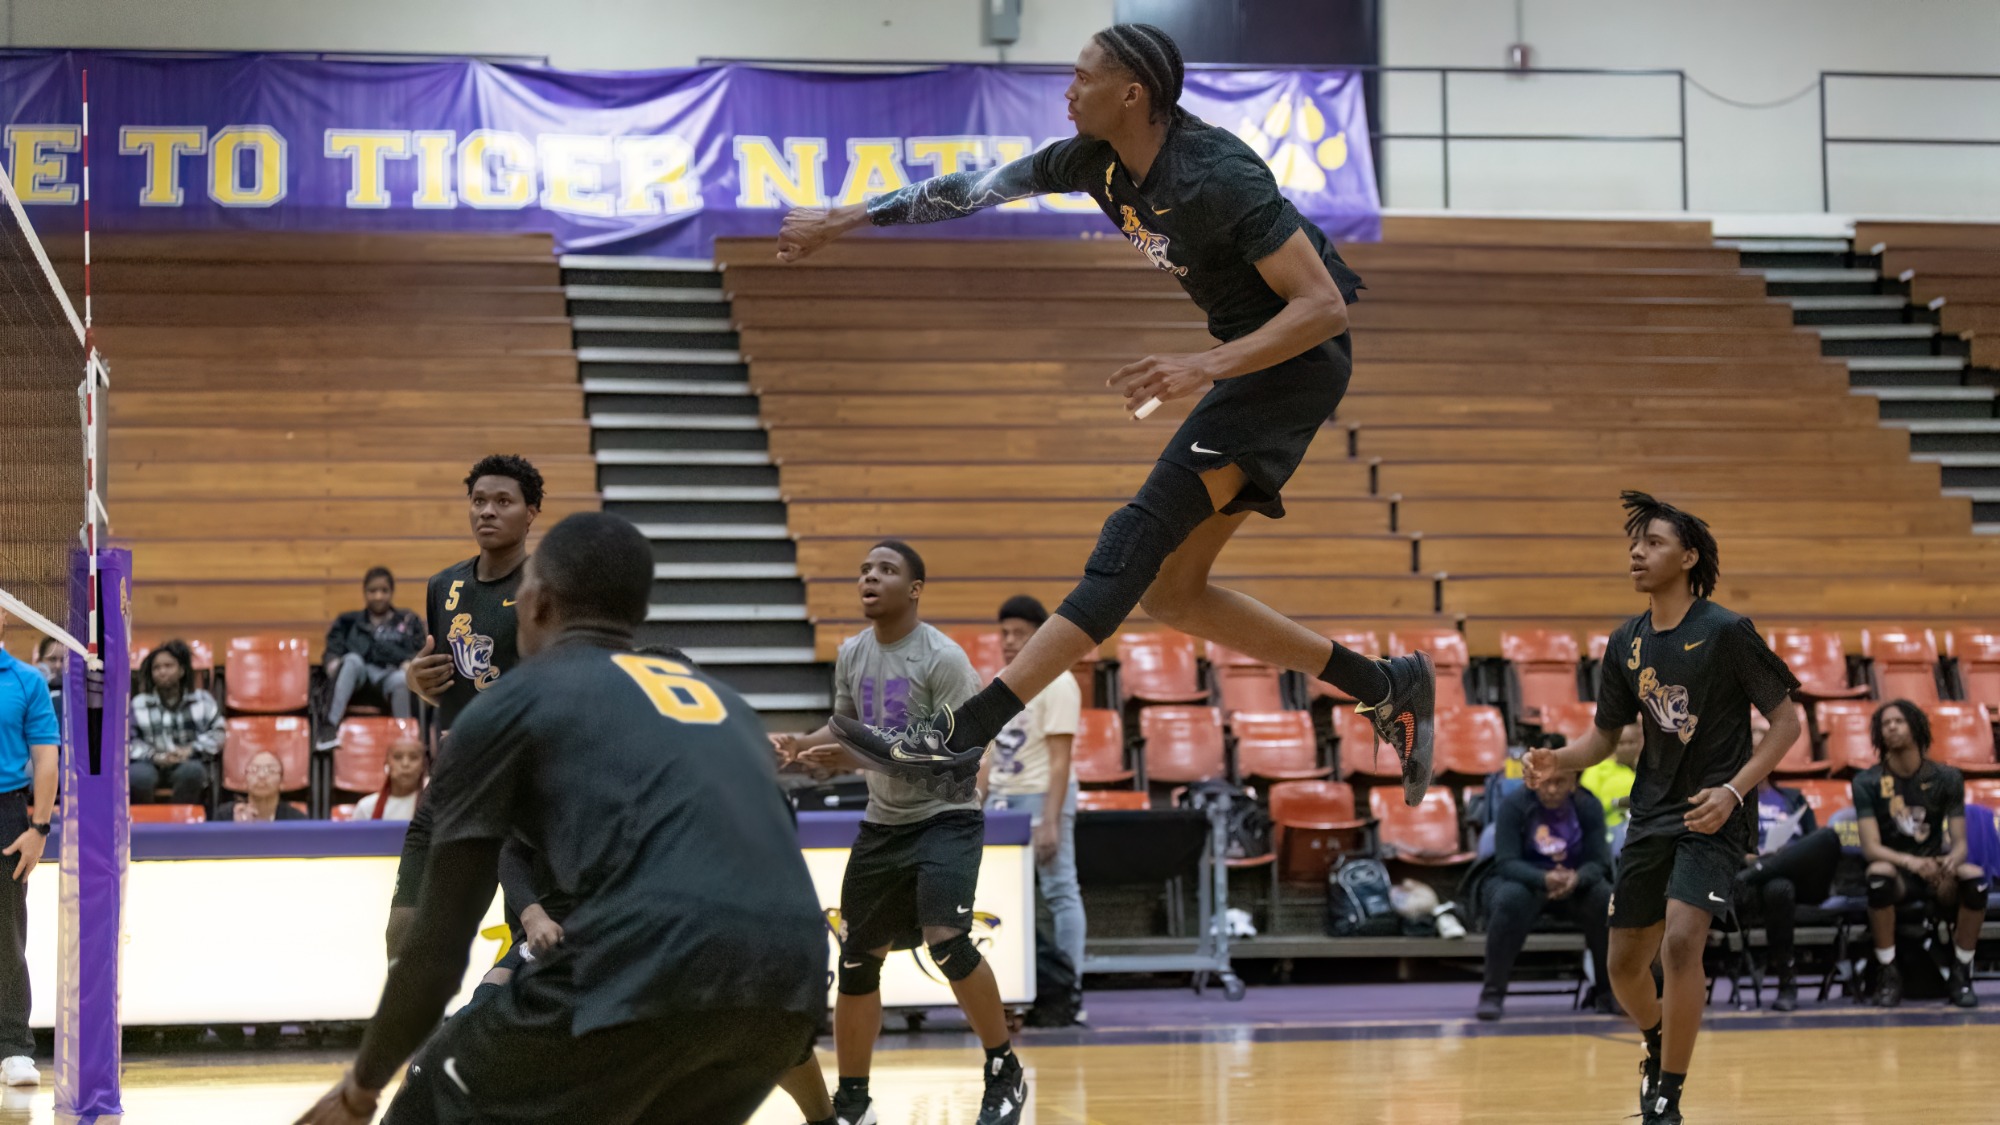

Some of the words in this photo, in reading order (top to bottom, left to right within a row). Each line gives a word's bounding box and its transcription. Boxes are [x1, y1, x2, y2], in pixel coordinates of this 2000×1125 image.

[118, 124, 288, 208] TO
[323, 127, 704, 218] TIGER
[445, 580, 465, 611] 5
[1627, 636, 1642, 670] 3
[610, 653, 728, 725] 6
